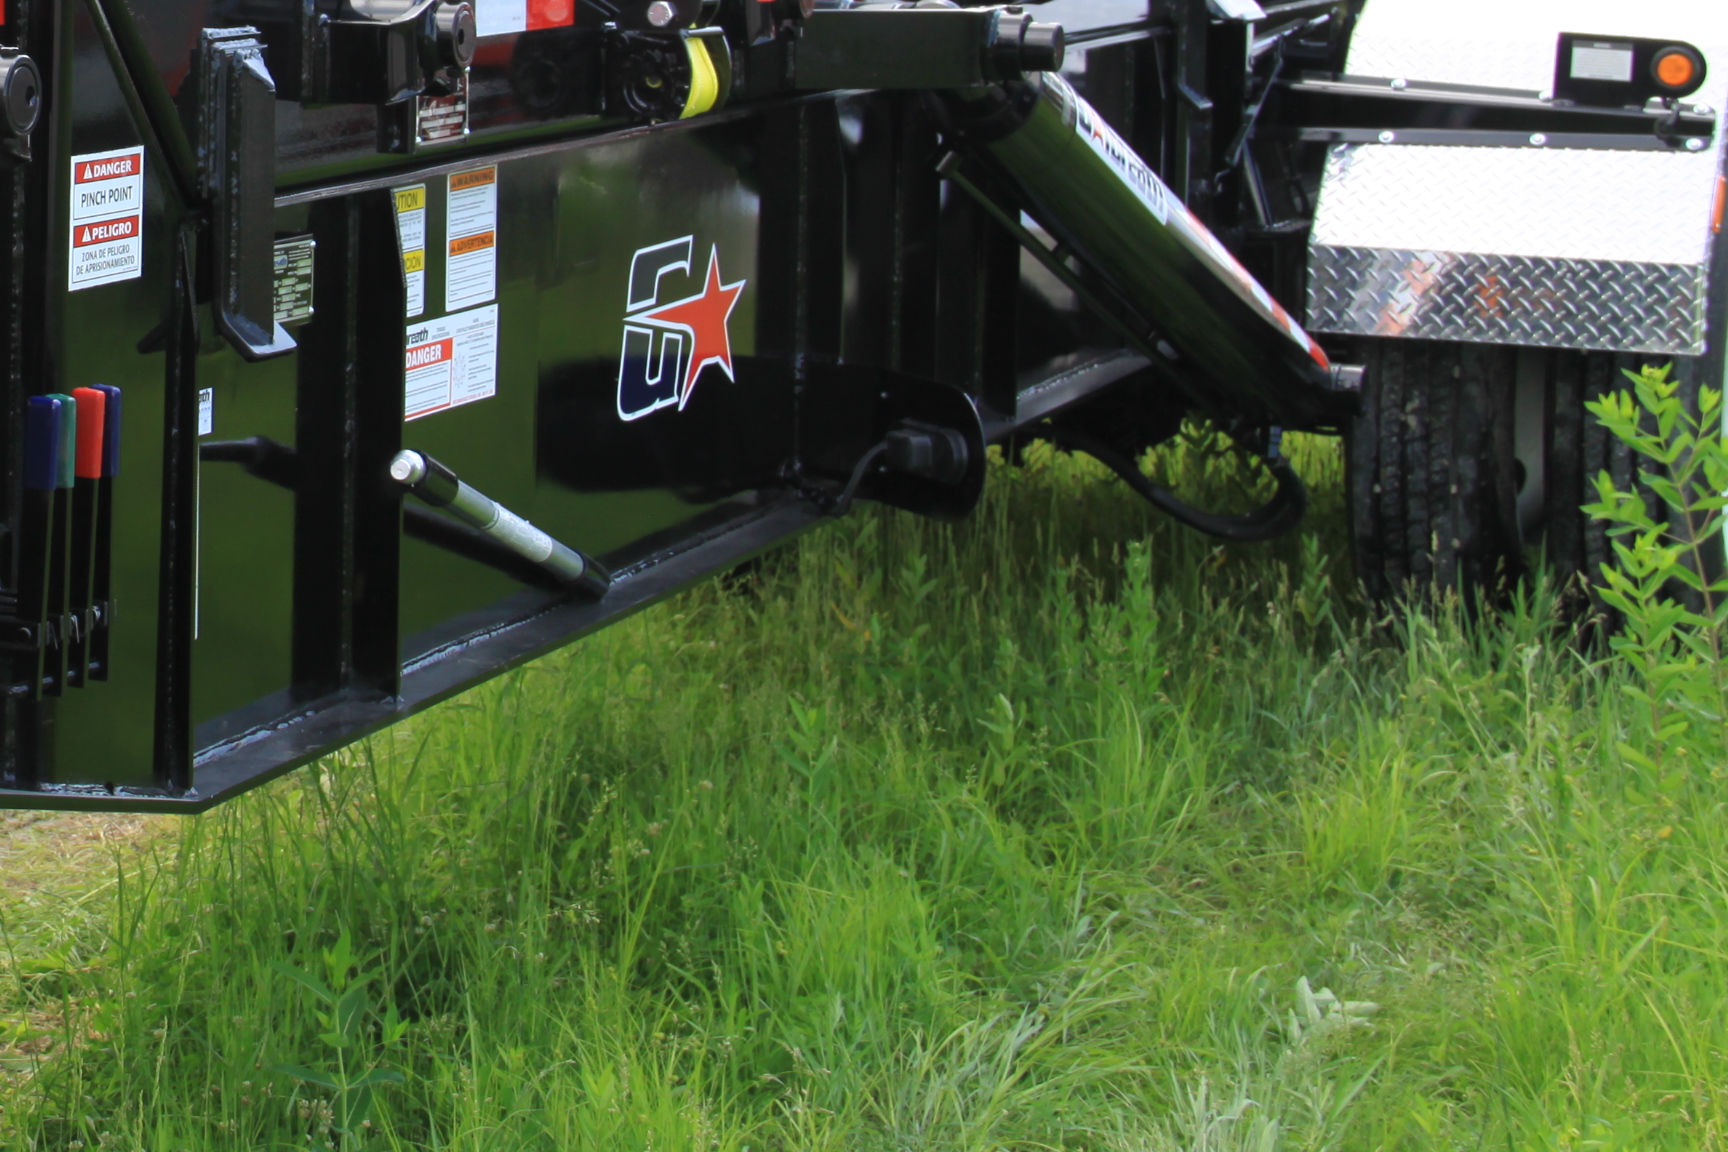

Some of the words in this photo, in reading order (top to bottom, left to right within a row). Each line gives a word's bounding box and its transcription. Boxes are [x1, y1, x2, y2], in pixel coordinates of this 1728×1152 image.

[93, 160, 133, 178] DANGER
[81, 190, 107, 208] PINCH
[108, 185, 134, 204] POINT
[92, 221, 132, 241] PELIGRO
[81, 250, 98, 263] ZONA
[98, 248, 107, 259] DE
[107, 244, 130, 257] PELIGRO
[76, 264, 84, 276] DE
[84, 255, 135, 274] APRISIONAMIENTO
[406, 344, 442, 368] DANGER
